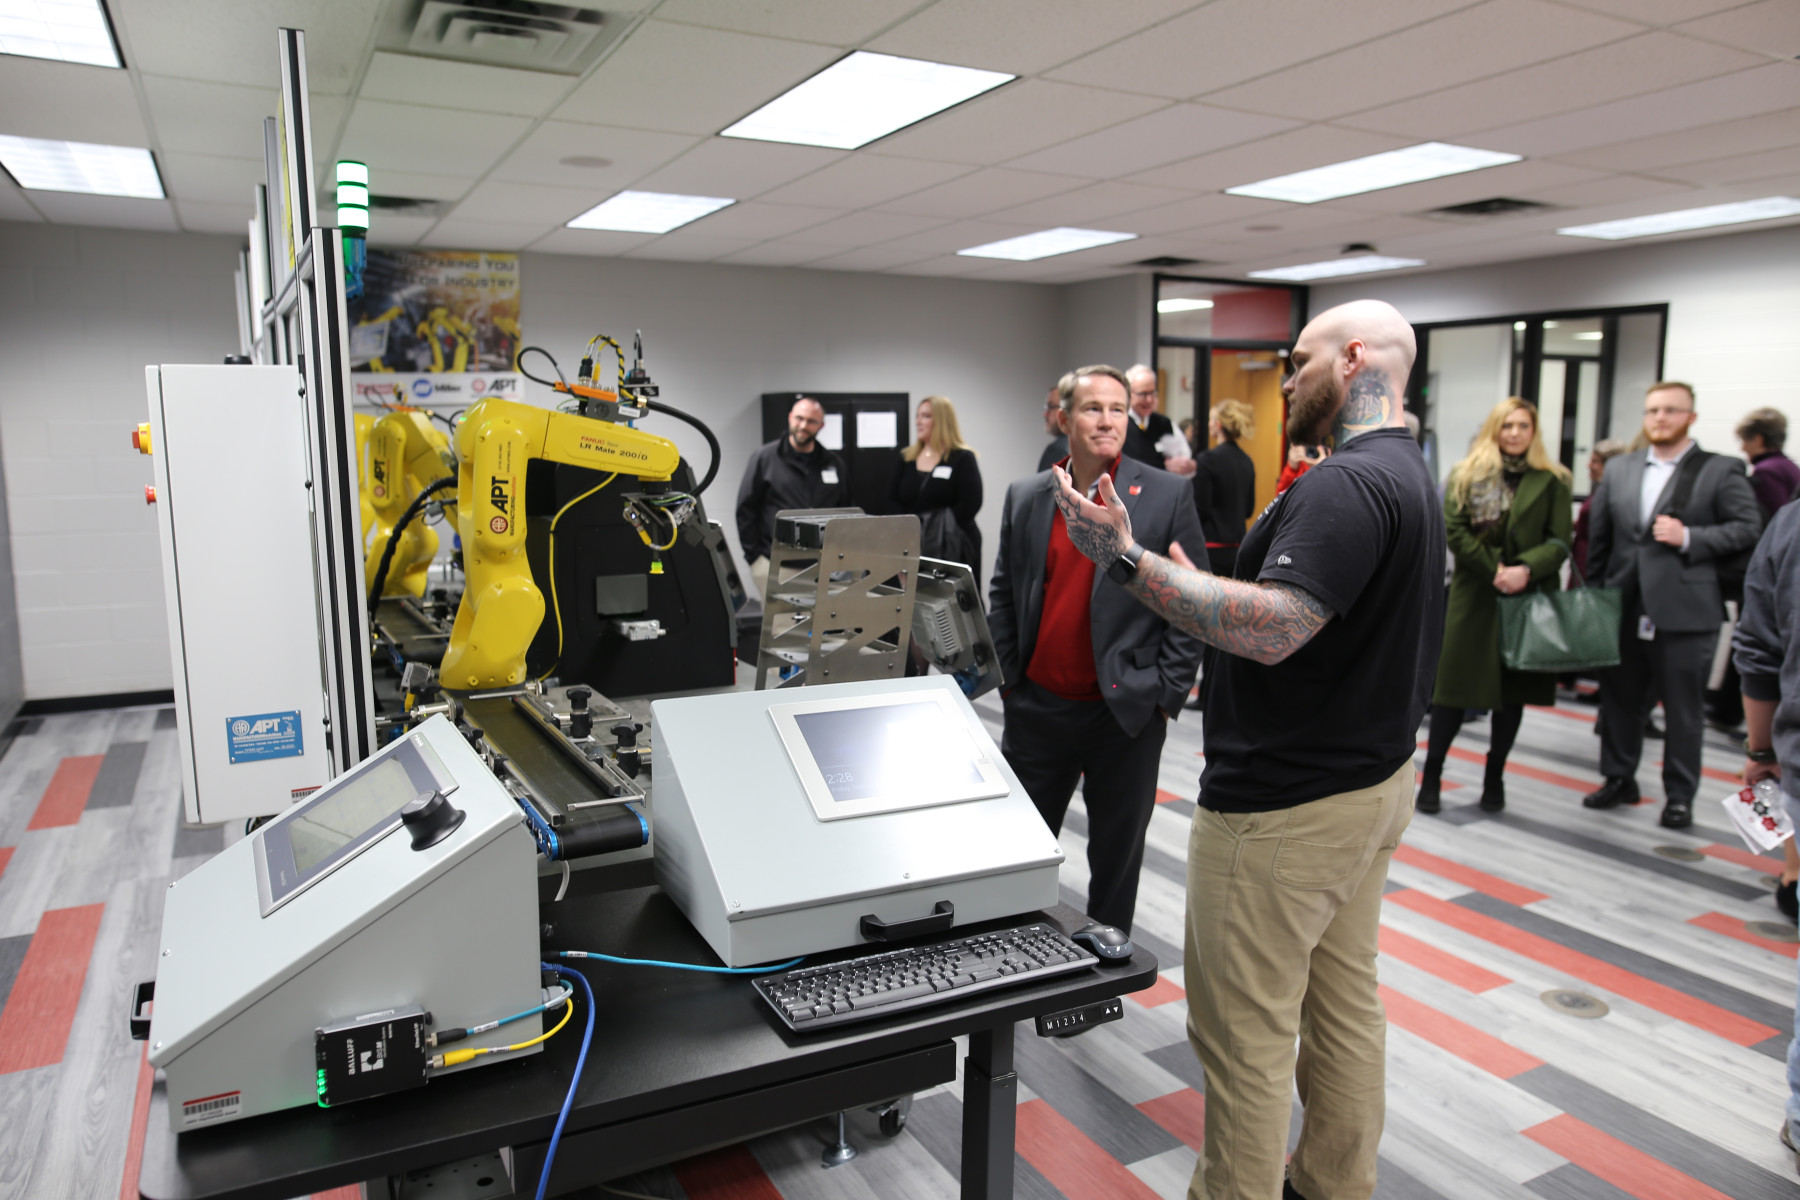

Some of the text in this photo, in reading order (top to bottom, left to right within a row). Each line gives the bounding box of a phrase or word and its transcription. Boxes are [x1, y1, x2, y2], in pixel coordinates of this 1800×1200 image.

[488, 379, 517, 392] APT
[580, 435, 605, 445] FANUC
[579, 442, 592, 450] LR
[595, 445, 616, 455] Mate
[491, 475, 509, 515] APT
[250, 718, 280, 734] APT
[827, 772, 853, 784] 2:28
[1047, 1013, 1084, 1030] M 1 2 3 4
[347, 1039, 355, 1075] BALLUFF
